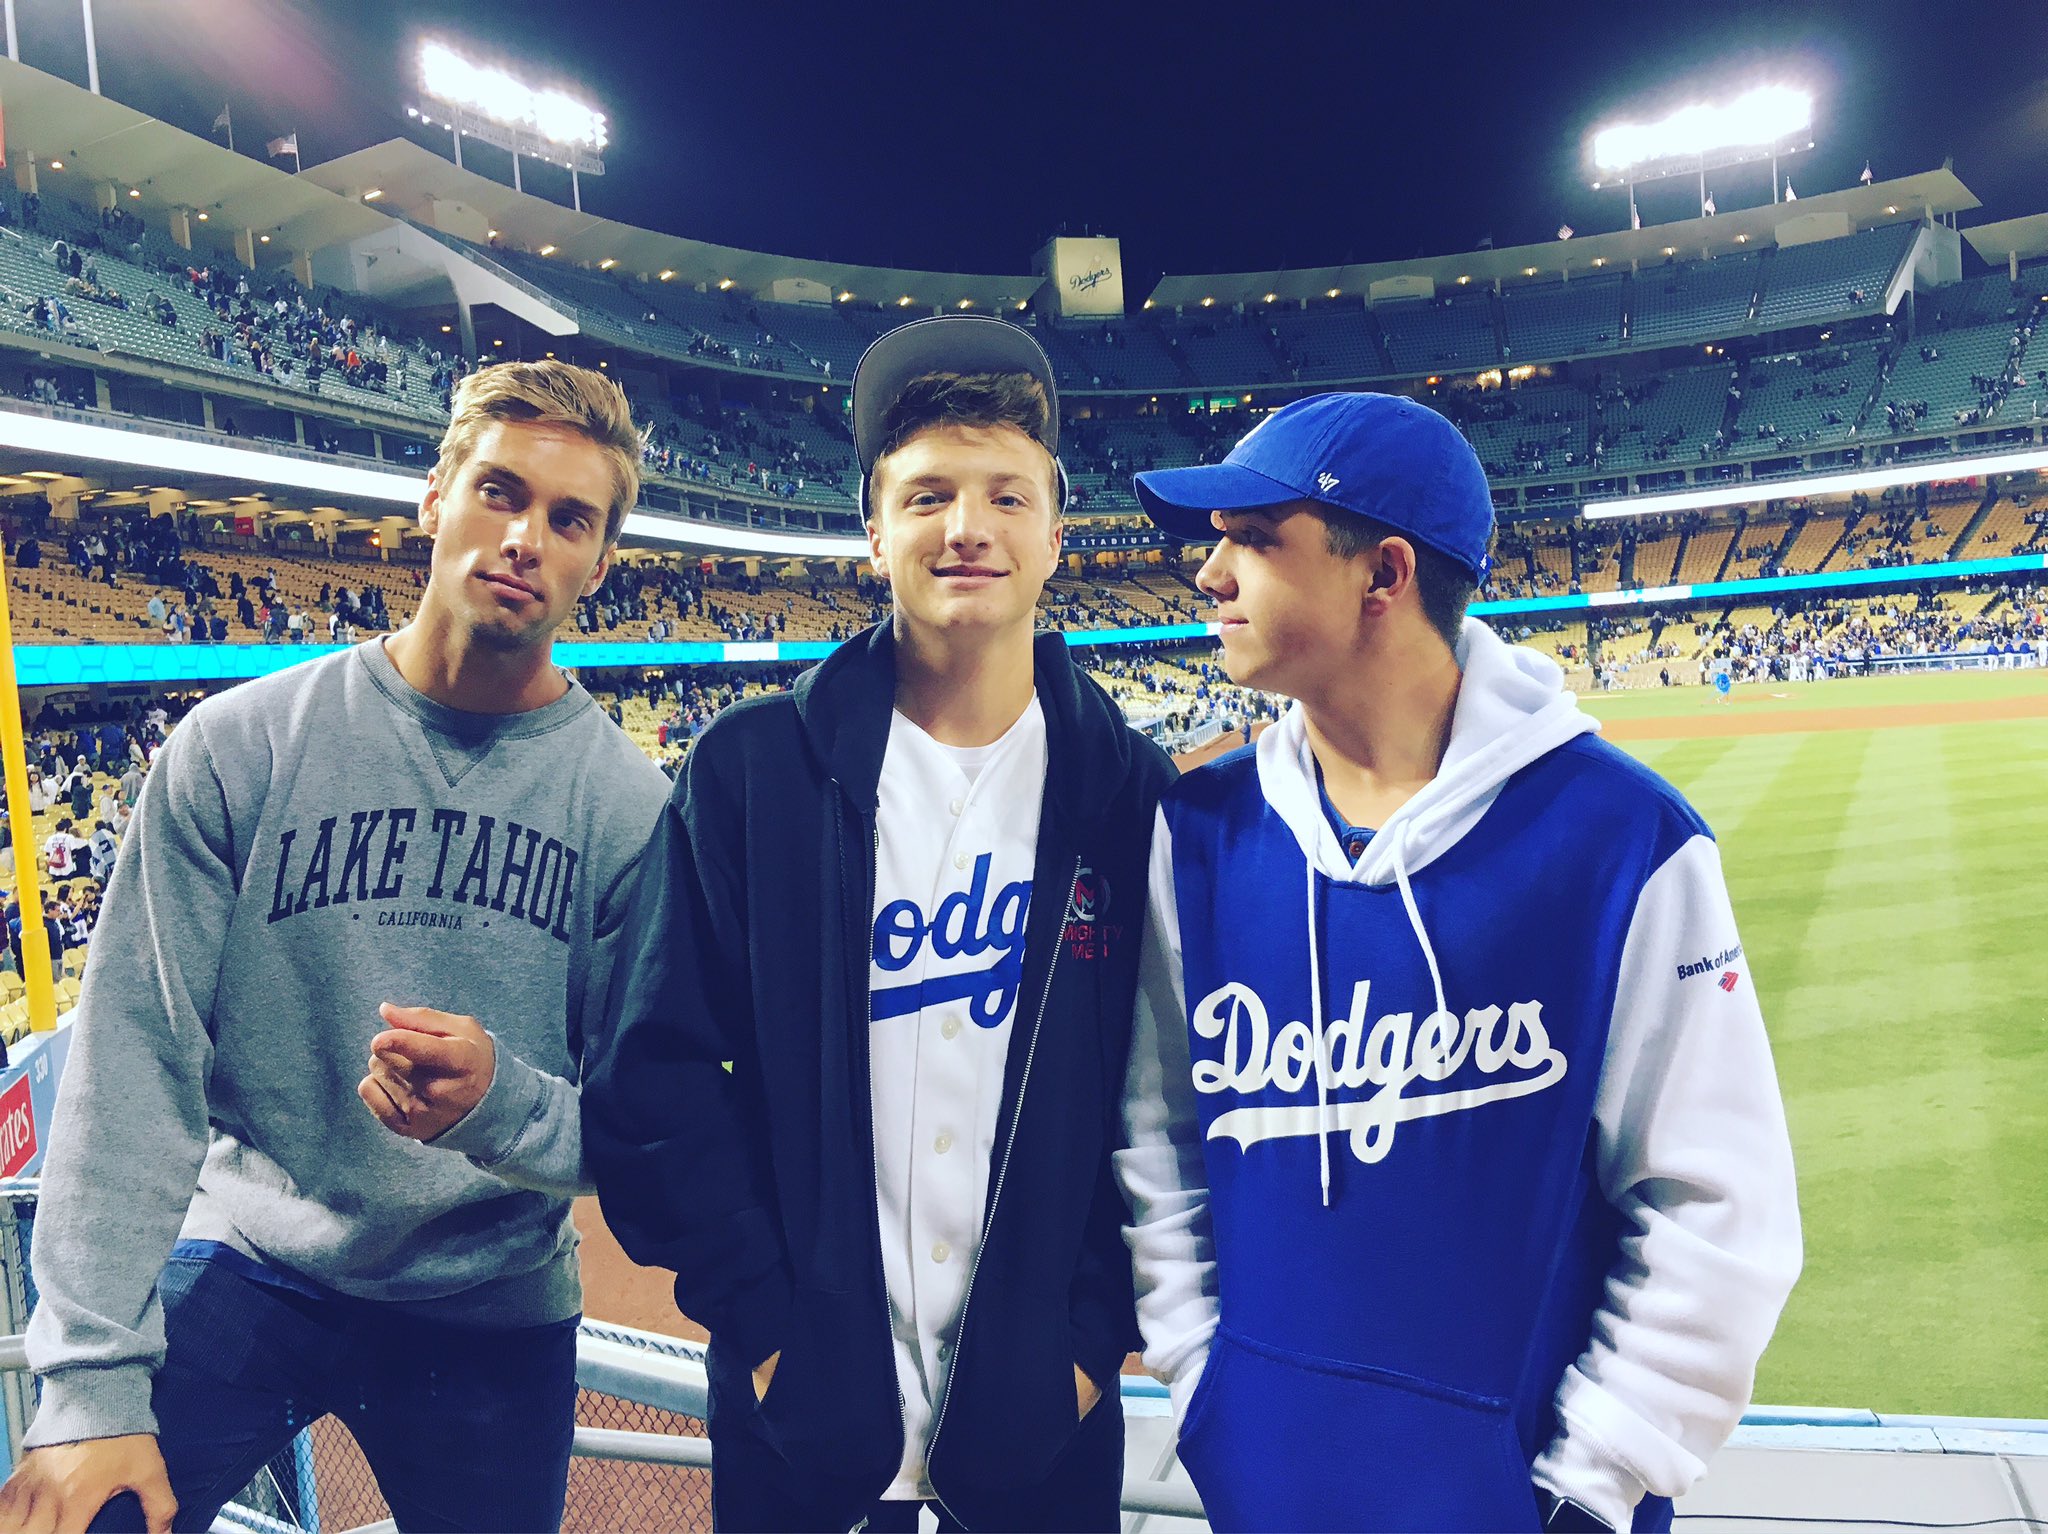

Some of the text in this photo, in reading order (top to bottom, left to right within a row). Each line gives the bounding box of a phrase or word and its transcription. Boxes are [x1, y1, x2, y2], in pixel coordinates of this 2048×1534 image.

[1069, 267, 1112, 292] Dodgers
[1081, 536, 1150, 546] STADIUM
[267, 808, 417, 924] LAKE
[378, 911, 463, 930] CALIFORNIA
[1677, 957, 1714, 981] Bank
[1714, 951, 1724, 969] of
[1191, 979, 1568, 1164] Dodgers
